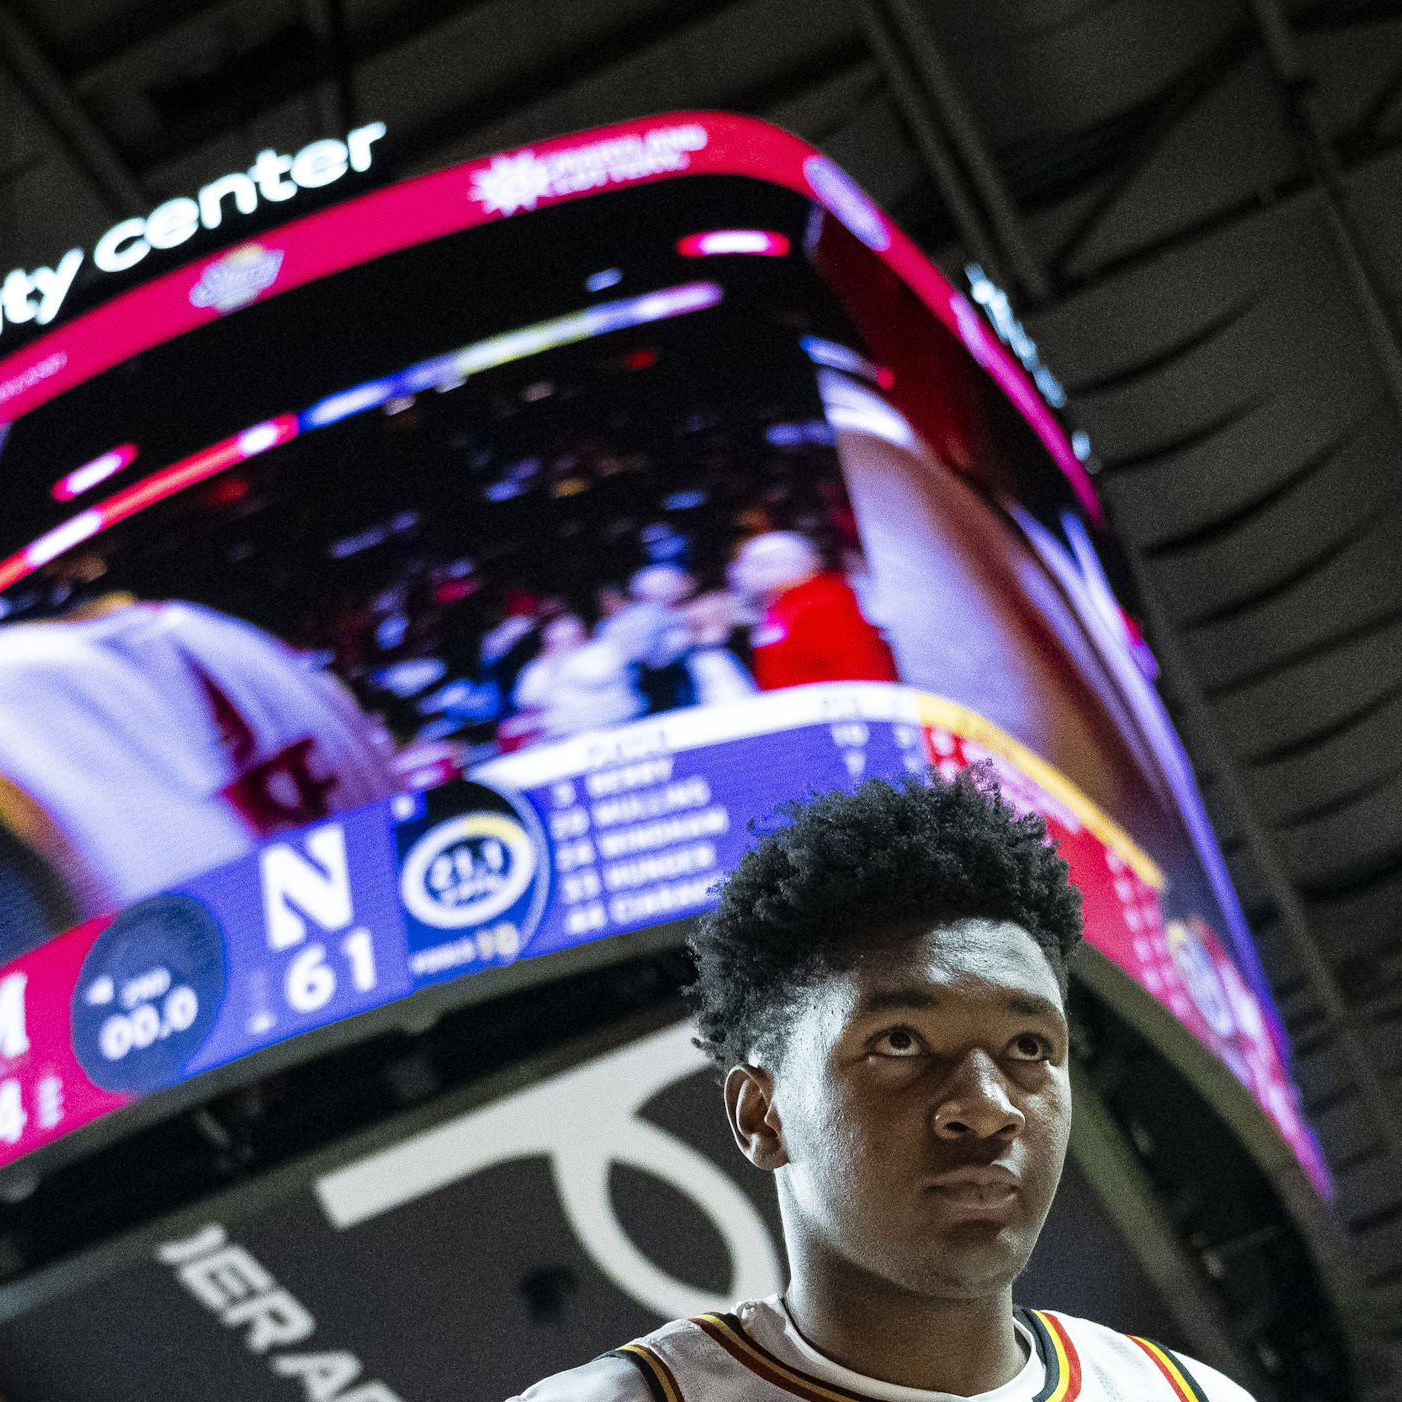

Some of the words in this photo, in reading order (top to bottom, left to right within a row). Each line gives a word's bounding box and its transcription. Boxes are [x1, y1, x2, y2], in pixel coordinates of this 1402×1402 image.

[93, 119, 387, 273] center
[260, 823, 354, 953] N
[100, 984, 199, 1062] 00.0
[284, 926, 377, 1013] 61
